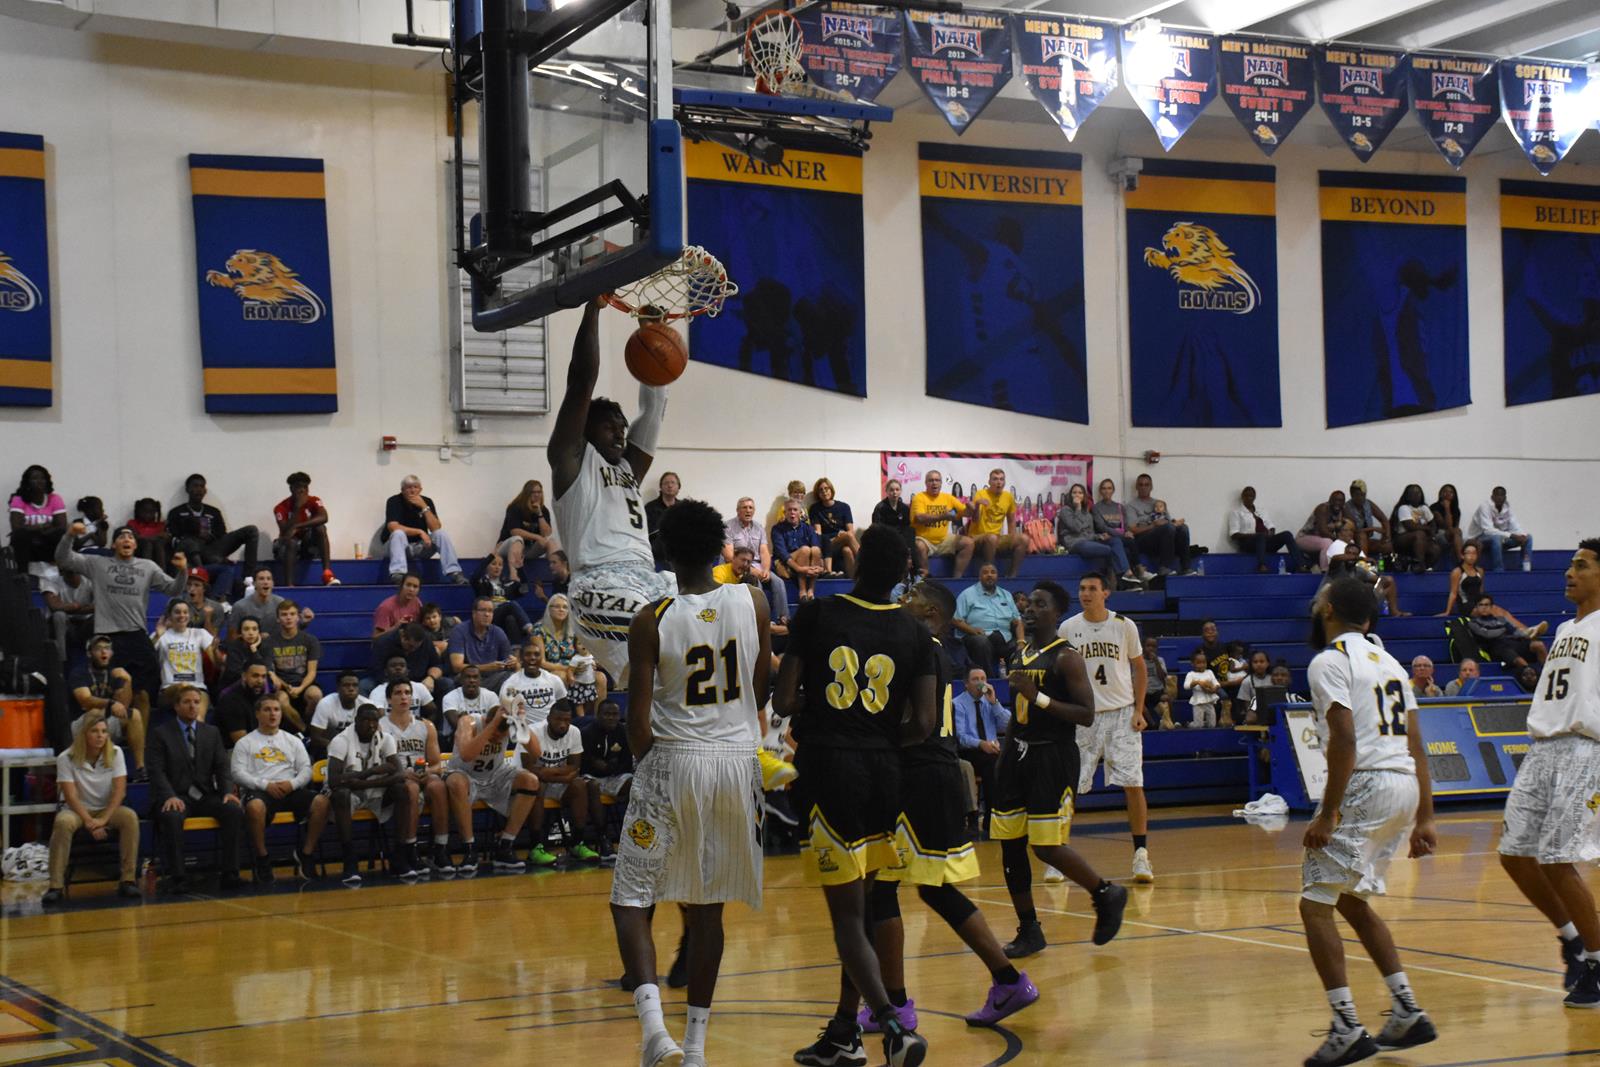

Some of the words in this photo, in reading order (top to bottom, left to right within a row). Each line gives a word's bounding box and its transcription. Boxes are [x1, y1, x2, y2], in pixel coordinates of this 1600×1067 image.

[823, 15, 871, 43] NAIA
[933, 28, 981, 52] NAIA
[1042, 38, 1087, 62] NAIA
[1245, 57, 1287, 79] NAIA
[1341, 67, 1381, 88] NAIA
[1515, 64, 1573, 84] SOFTBALL
[836, 74, 861, 88] 26-7
[1433, 74, 1473, 95] NAIA
[946, 86, 970, 98] 18-6
[1254, 110, 1280, 123] 24-11
[1352, 115, 1373, 128] 13-5
[1443, 122, 1465, 134] 17-8
[932, 170, 1069, 196] UNIVERSITY
[1350, 196, 1436, 216] BEYOND
[1179, 290, 1249, 311] ROYALS
[242, 302, 315, 321] ROYALS
[626, 498, 643, 530] 5
[1547, 636, 1589, 663] ARNER
[684, 636, 742, 706] 21
[825, 645, 895, 714] 33
[1094, 664, 1108, 686] 4
[1544, 667, 1570, 702] 15
[1373, 679, 1408, 737] 12
[1427, 741, 1459, 755] HOME
[473, 758, 496, 773] 24
